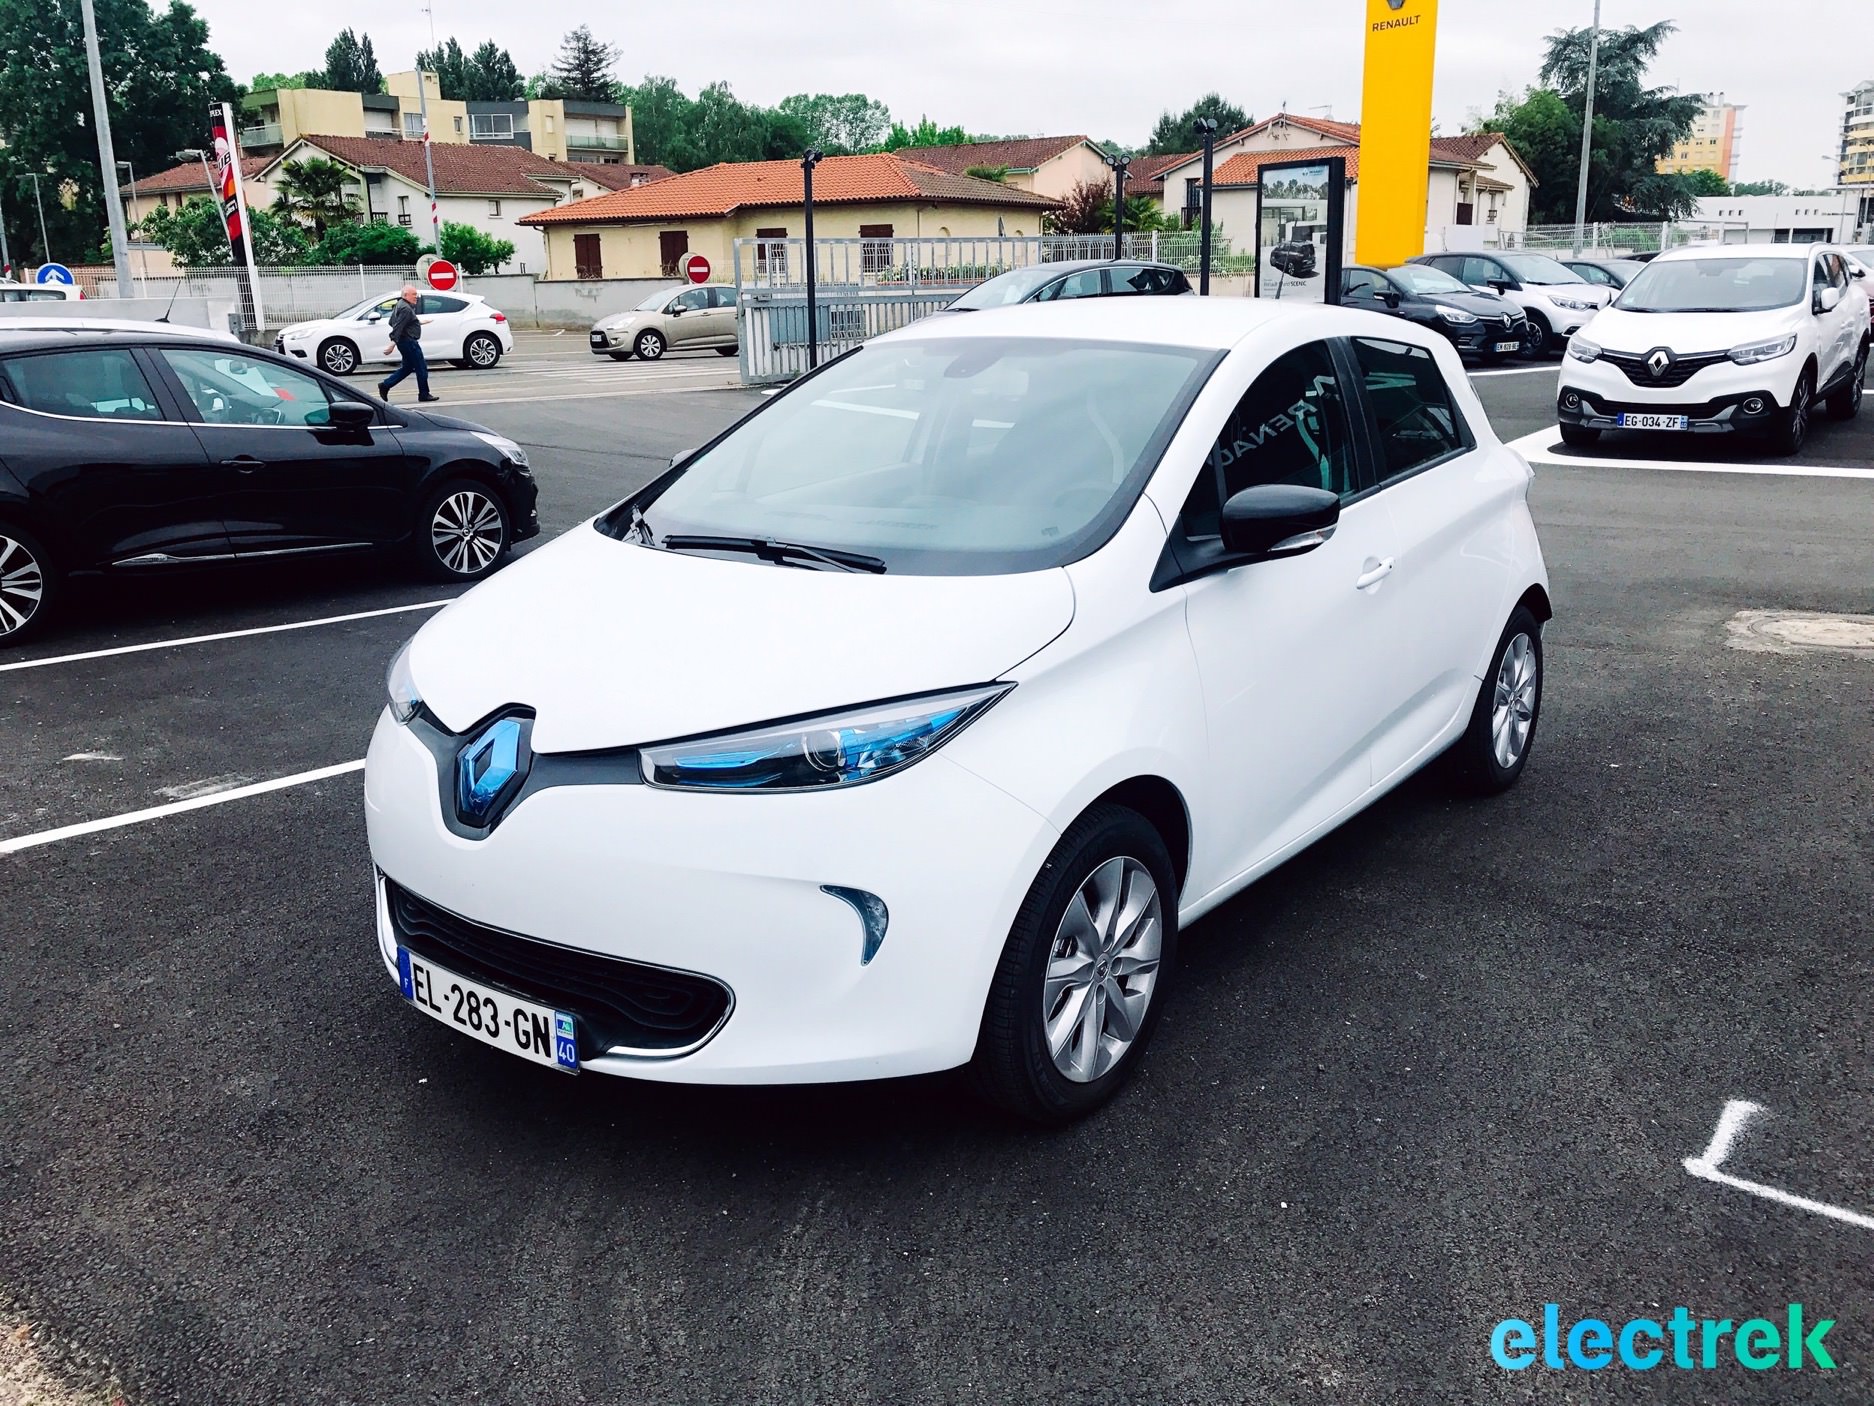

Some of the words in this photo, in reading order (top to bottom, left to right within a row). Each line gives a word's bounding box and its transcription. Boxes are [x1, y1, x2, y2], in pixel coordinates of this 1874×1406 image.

[1372, 15, 1421, 32] RENAULT
[1624, 416, 1680, 428] EG-034-ZF
[413, 962, 551, 1058] EL-283-GN
[559, 1041, 575, 1062] 40
